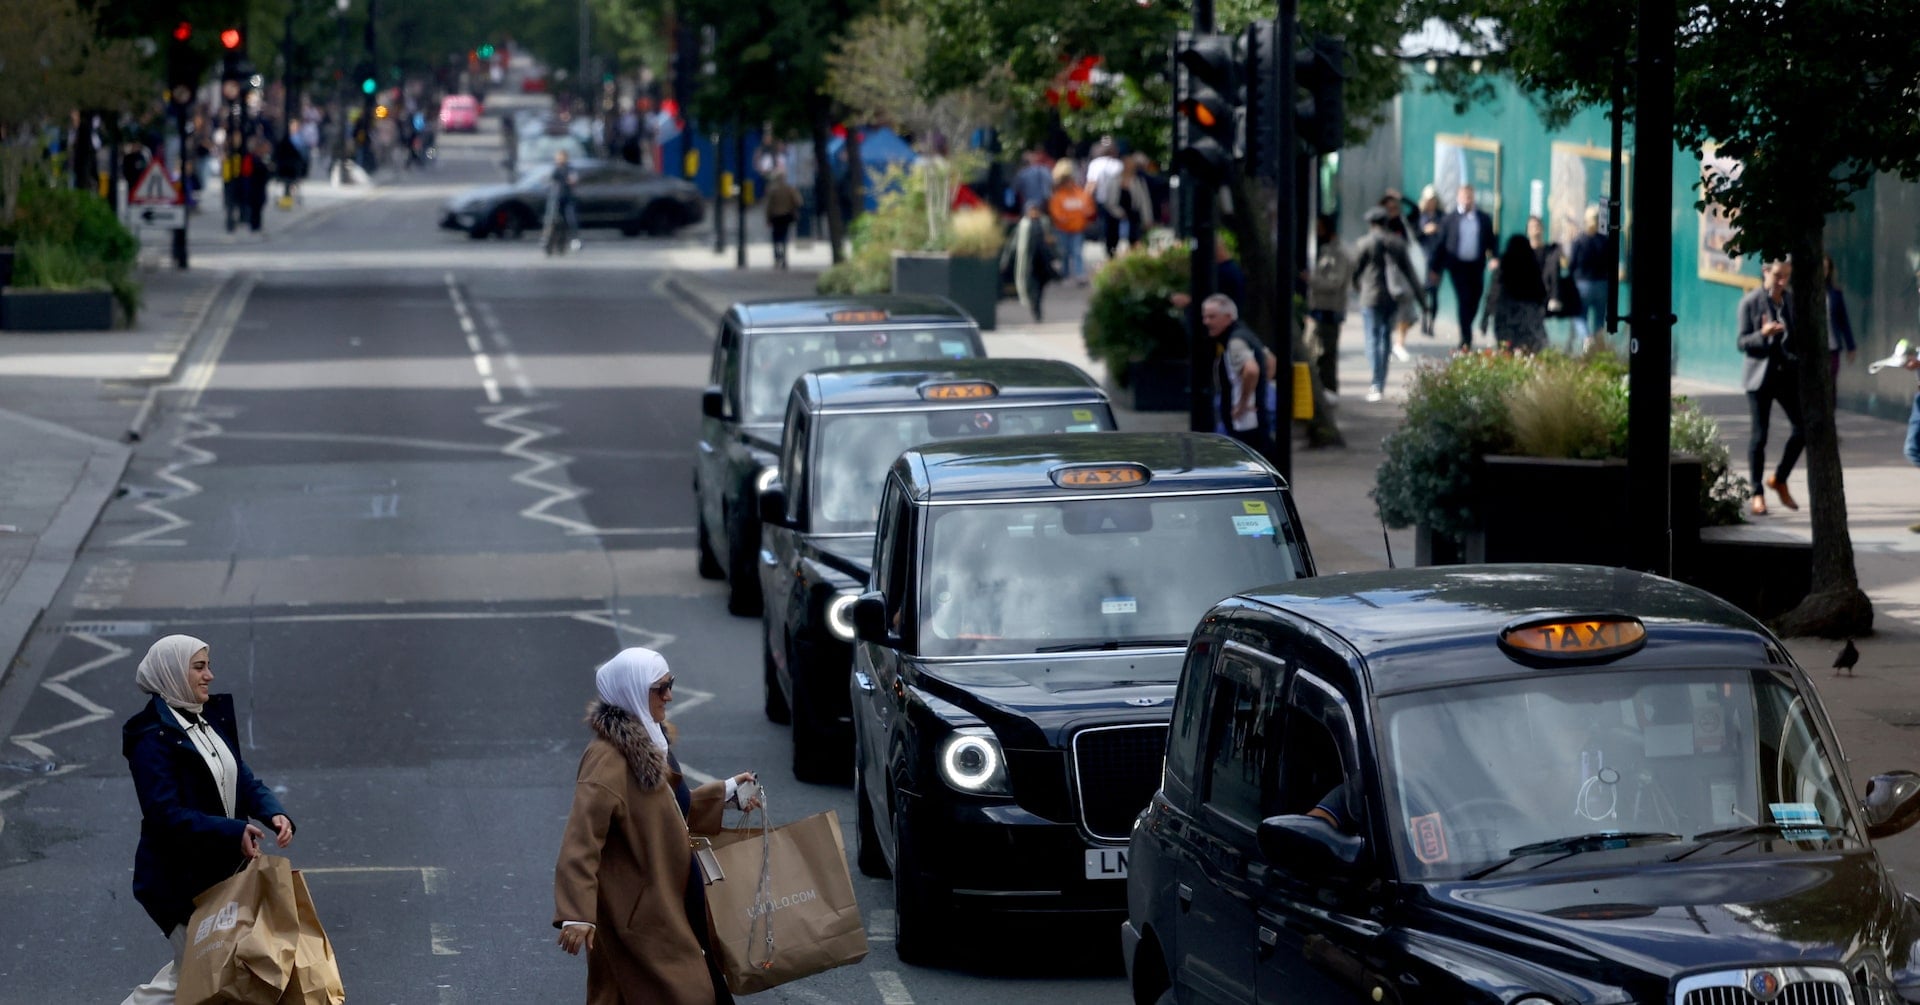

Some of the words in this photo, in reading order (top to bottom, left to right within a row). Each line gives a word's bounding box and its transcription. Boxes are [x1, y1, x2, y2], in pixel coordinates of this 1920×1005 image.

[932, 385, 986, 398] TAXI
[1068, 469, 1135, 483] TAXI
[1537, 623, 1622, 650] TAXI
[1101, 851, 1129, 873] LN
